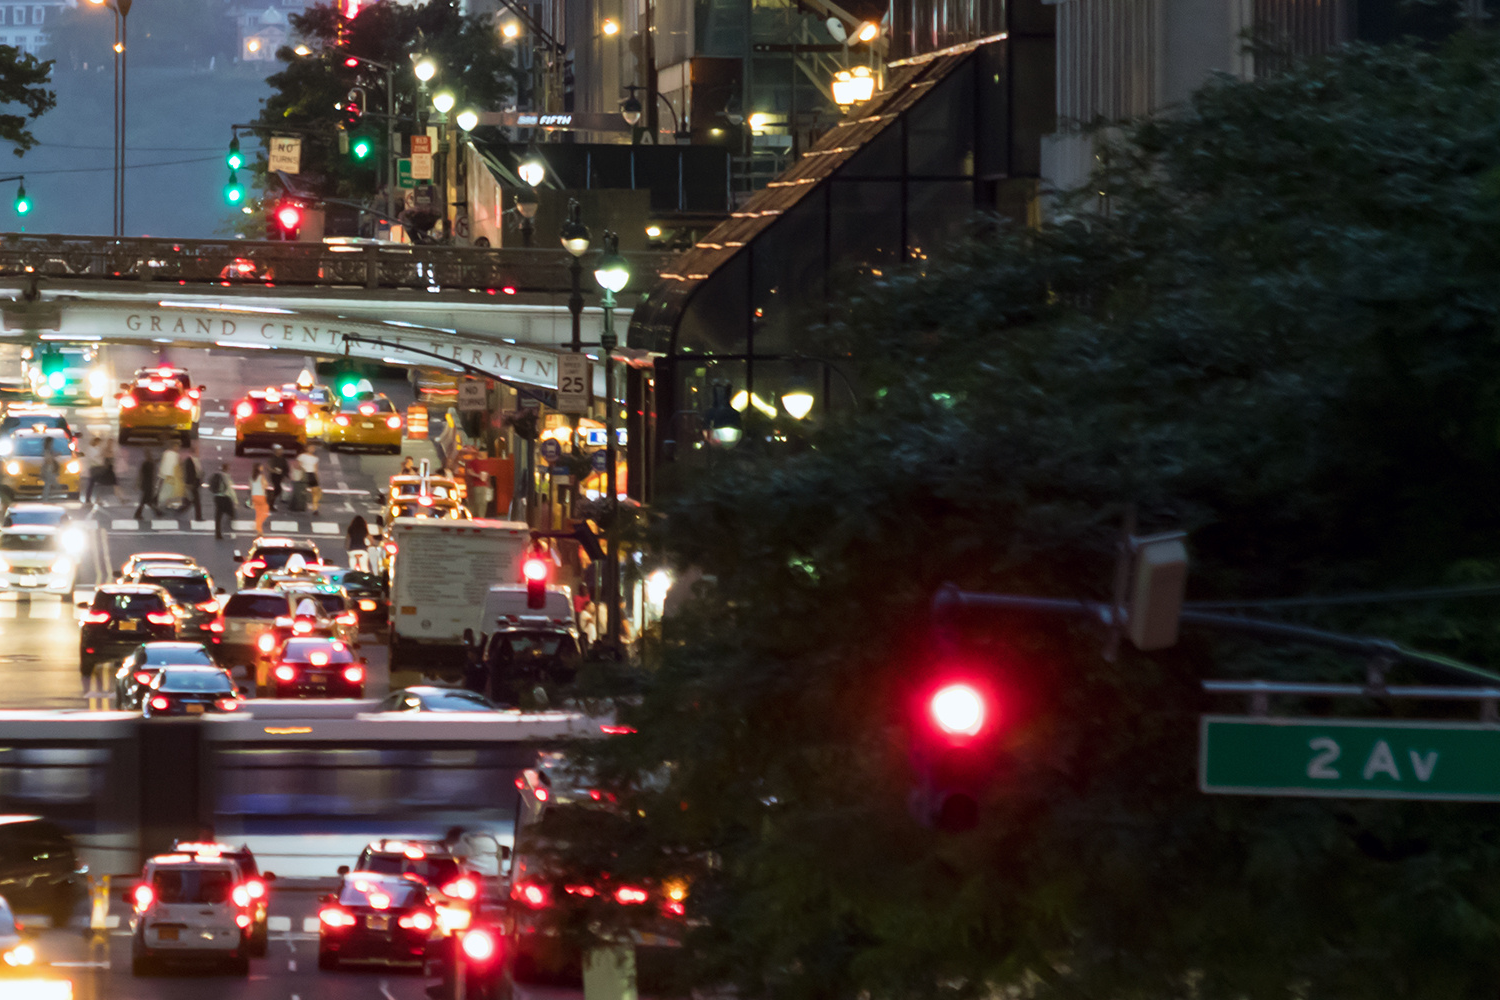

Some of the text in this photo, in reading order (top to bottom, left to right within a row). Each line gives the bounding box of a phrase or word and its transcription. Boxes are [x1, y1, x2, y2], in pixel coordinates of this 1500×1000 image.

[539, 114, 572, 125] FIFTH
[278, 143, 294, 153] NO
[271, 154, 299, 165] TURNS
[126, 314, 236, 336] GRAND
[261, 323, 405, 354] CENTRAL
[562, 376, 584, 393] 25
[465, 386, 478, 395] NO
[1306, 737, 1440, 782] 2 Av
